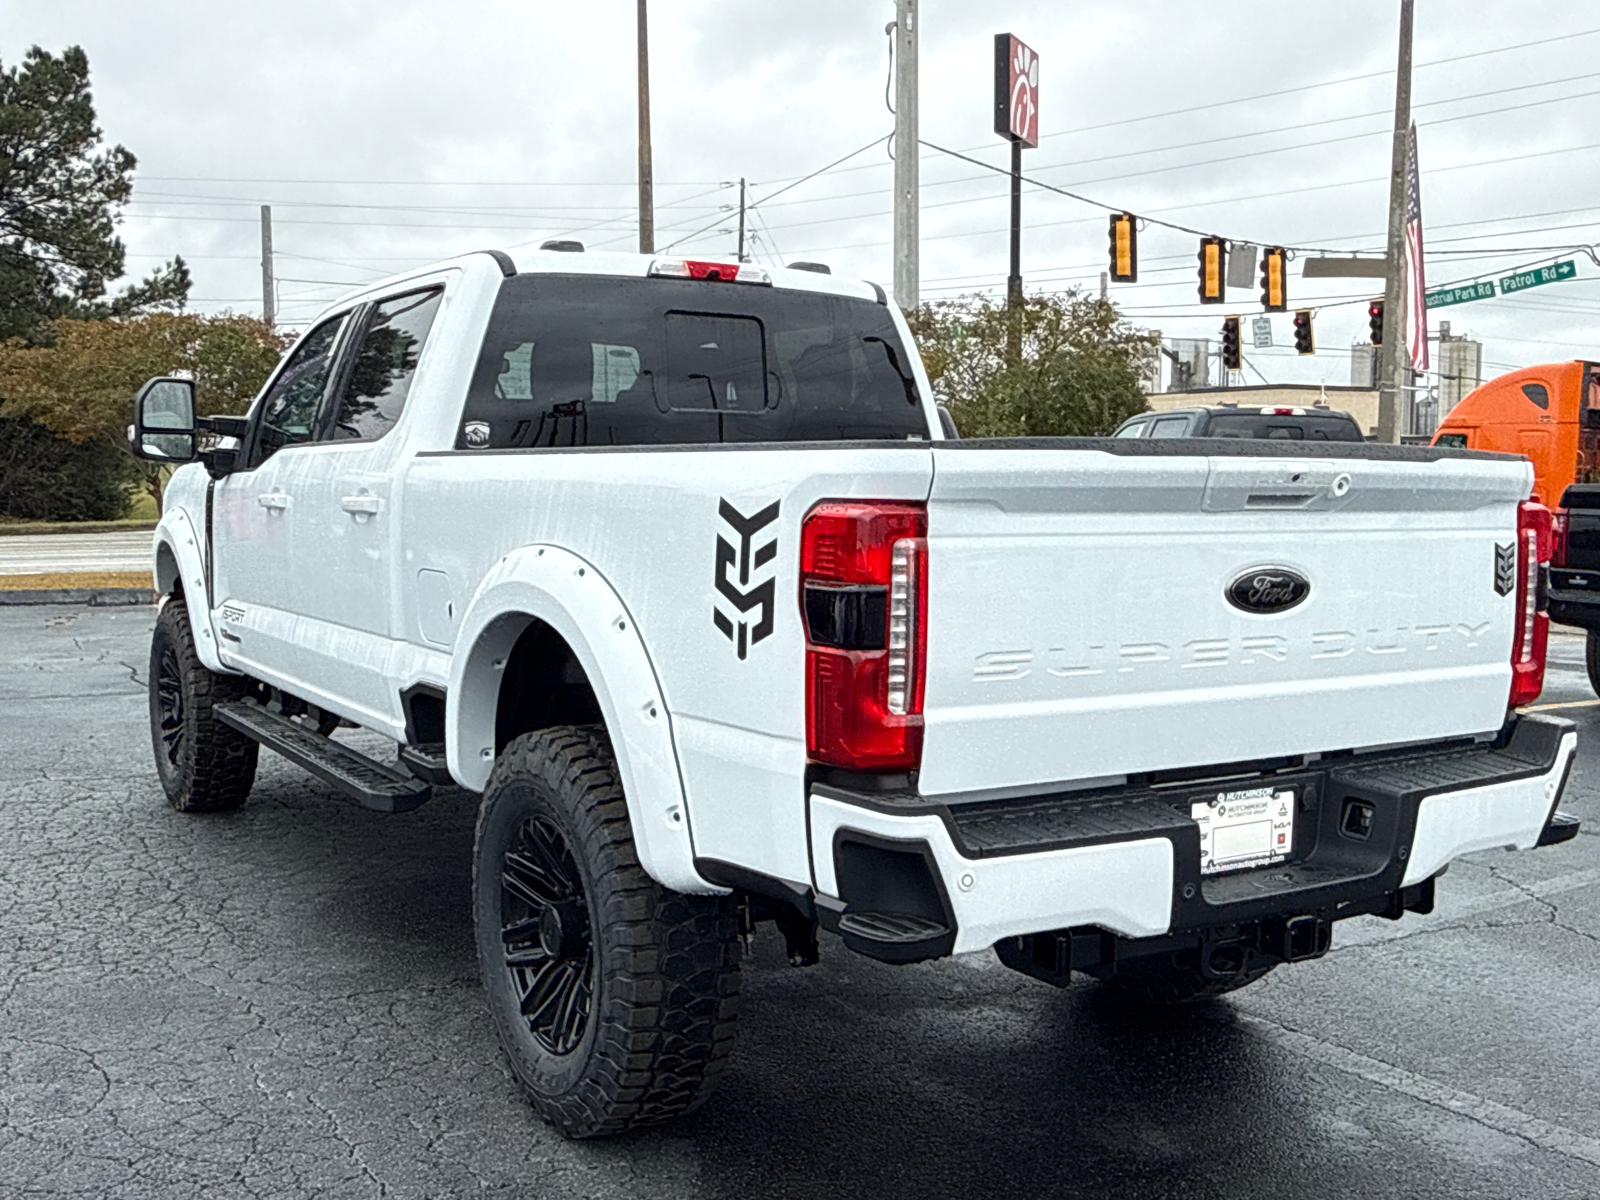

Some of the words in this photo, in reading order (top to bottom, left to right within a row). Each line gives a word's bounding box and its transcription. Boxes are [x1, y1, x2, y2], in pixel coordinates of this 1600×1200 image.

[1502, 273, 1535, 290] Patrol
[1541, 267, 1557, 281] Rd
[1426, 292, 1453, 306] ustrial
[1454, 287, 1477, 301] Park
[1477, 284, 1492, 297] Rd
[1248, 575, 1295, 604] Ford
[973, 636, 1288, 682] SUPER
[1311, 621, 1491, 660] DUTY
[1226, 787, 1274, 800] HUTCHINSON
